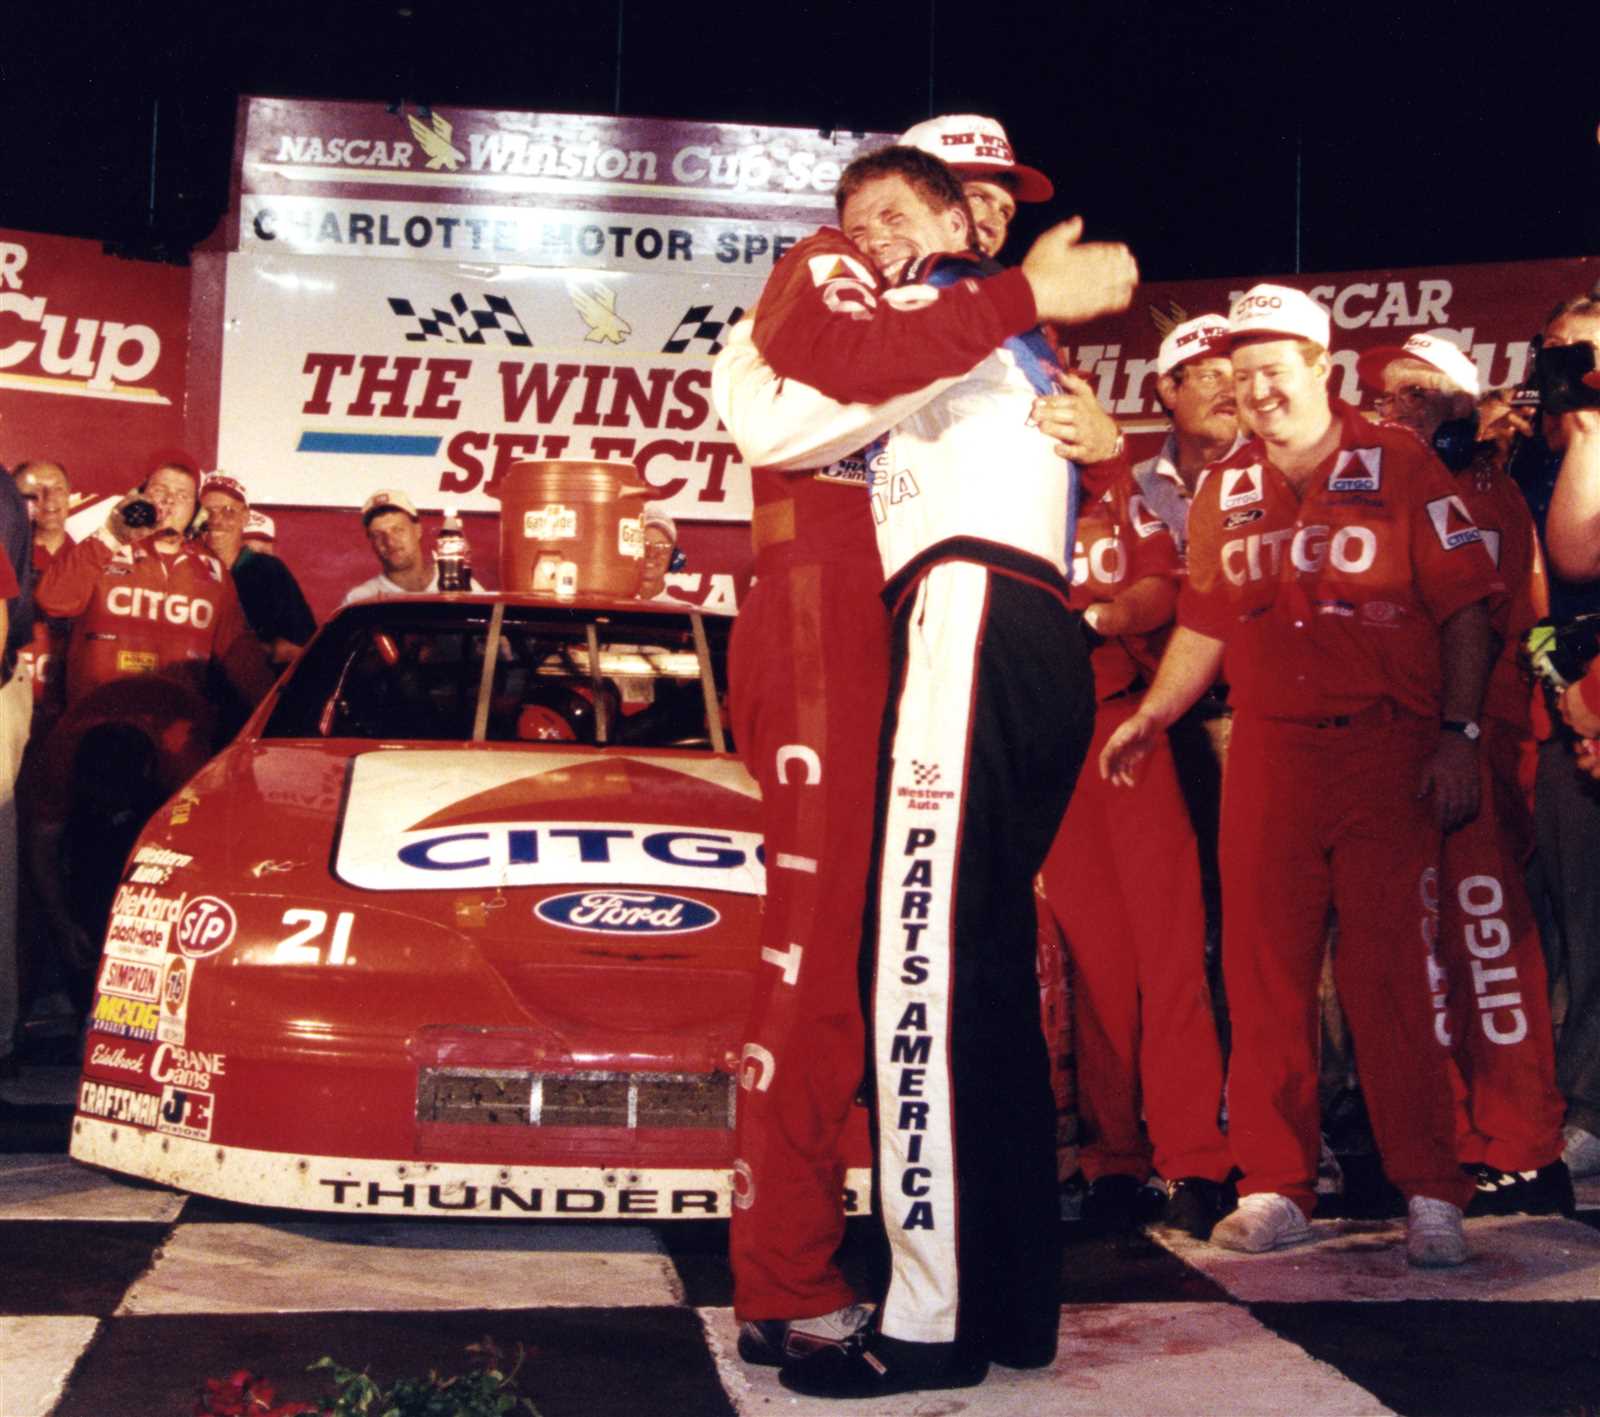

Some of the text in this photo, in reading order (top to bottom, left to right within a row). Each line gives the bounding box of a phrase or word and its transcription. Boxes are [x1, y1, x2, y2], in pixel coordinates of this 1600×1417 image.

[275, 130, 844, 191] NASCAR Winston Cup Se
[714, 231, 797, 266] SPE
[302, 352, 724, 431] THE WINS
[1221, 524, 1377, 587] CITGO
[107, 586, 213, 630] CITGO
[897, 786, 954, 799] Western
[907, 798, 940, 810] Auto
[398, 828, 768, 874] CITG
[112, 885, 188, 923] DieHard
[181, 902, 225, 946] STP
[569, 892, 684, 929] Ford
[277, 908, 355, 965] 21
[106, 962, 158, 995] SIMPSON
[1457, 875, 1528, 1046] CITGO
[94, 994, 161, 1031] MOOG
[890, 827, 937, 1232] PARTS AMERICA
[91, 1043, 145, 1074] Edelbrock
[79, 1080, 161, 1128] CRAFTSMAN
